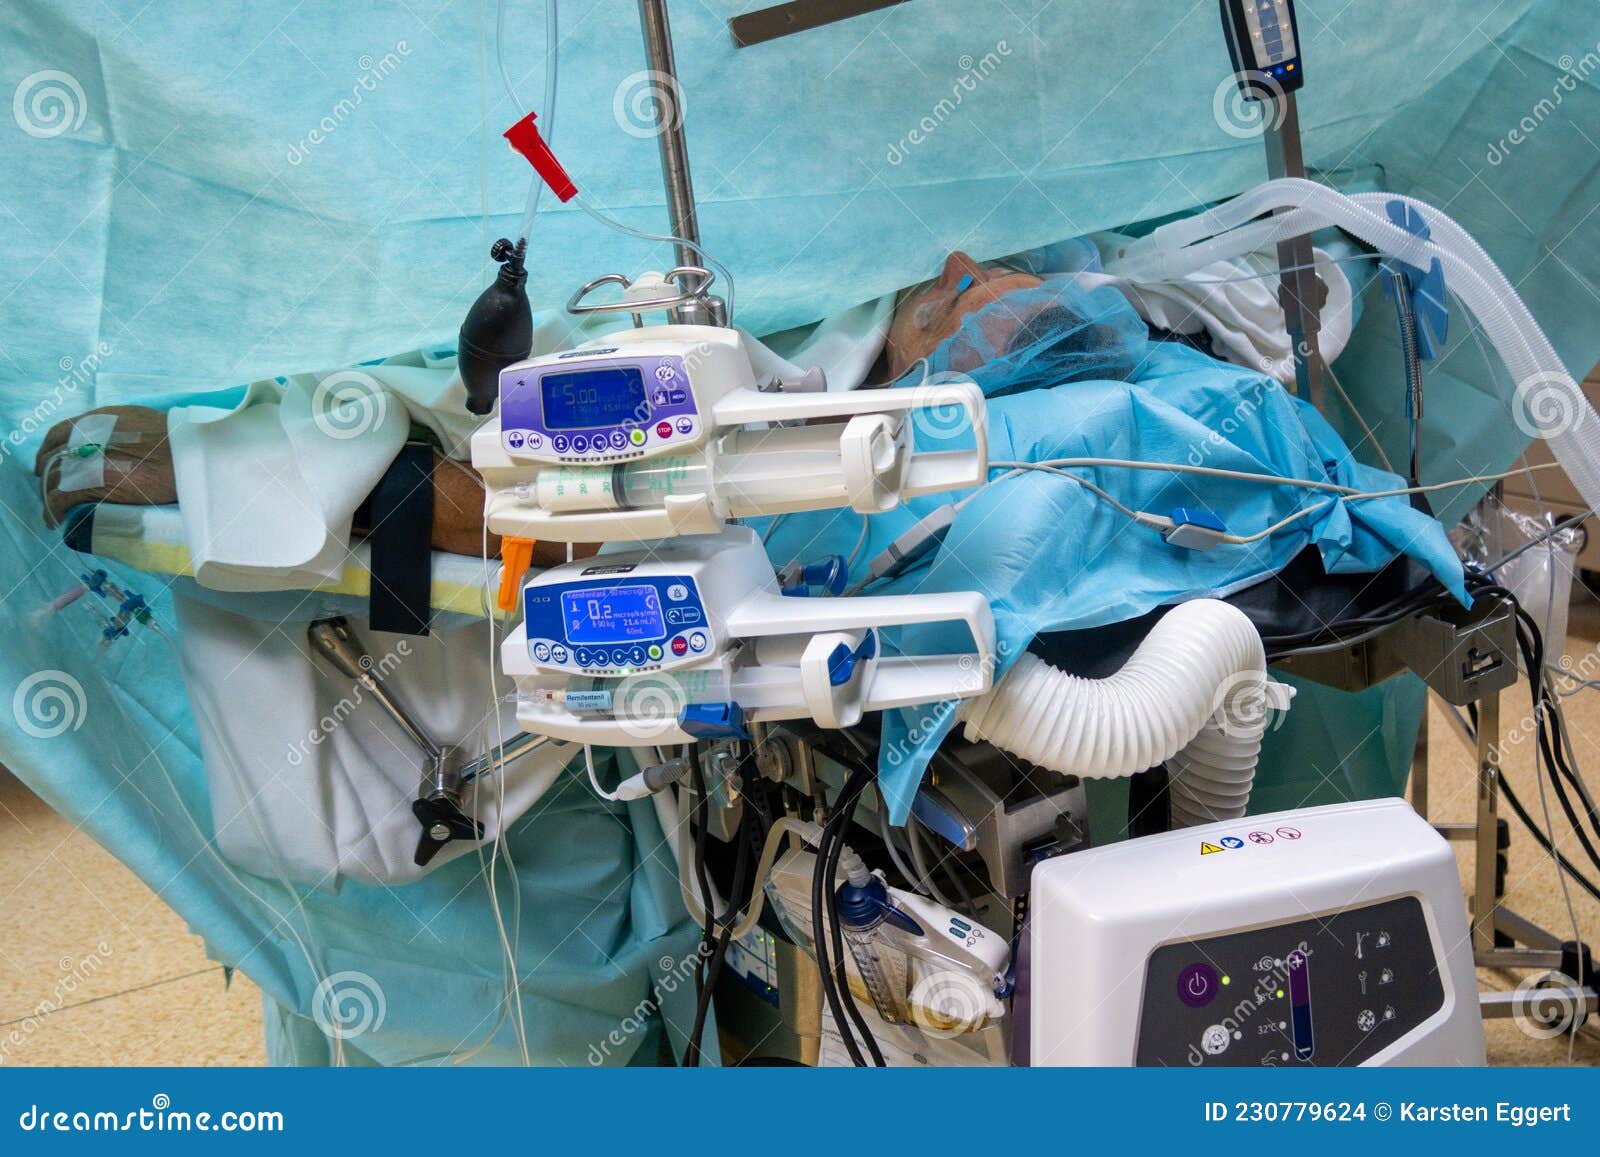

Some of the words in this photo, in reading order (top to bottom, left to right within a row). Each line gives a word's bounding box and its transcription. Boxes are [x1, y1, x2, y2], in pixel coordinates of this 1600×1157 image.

[657, 426, 672, 434] STOP
[587, 599, 613, 620] 0.2
[1257, 1022, 1277, 1034] 32°C
